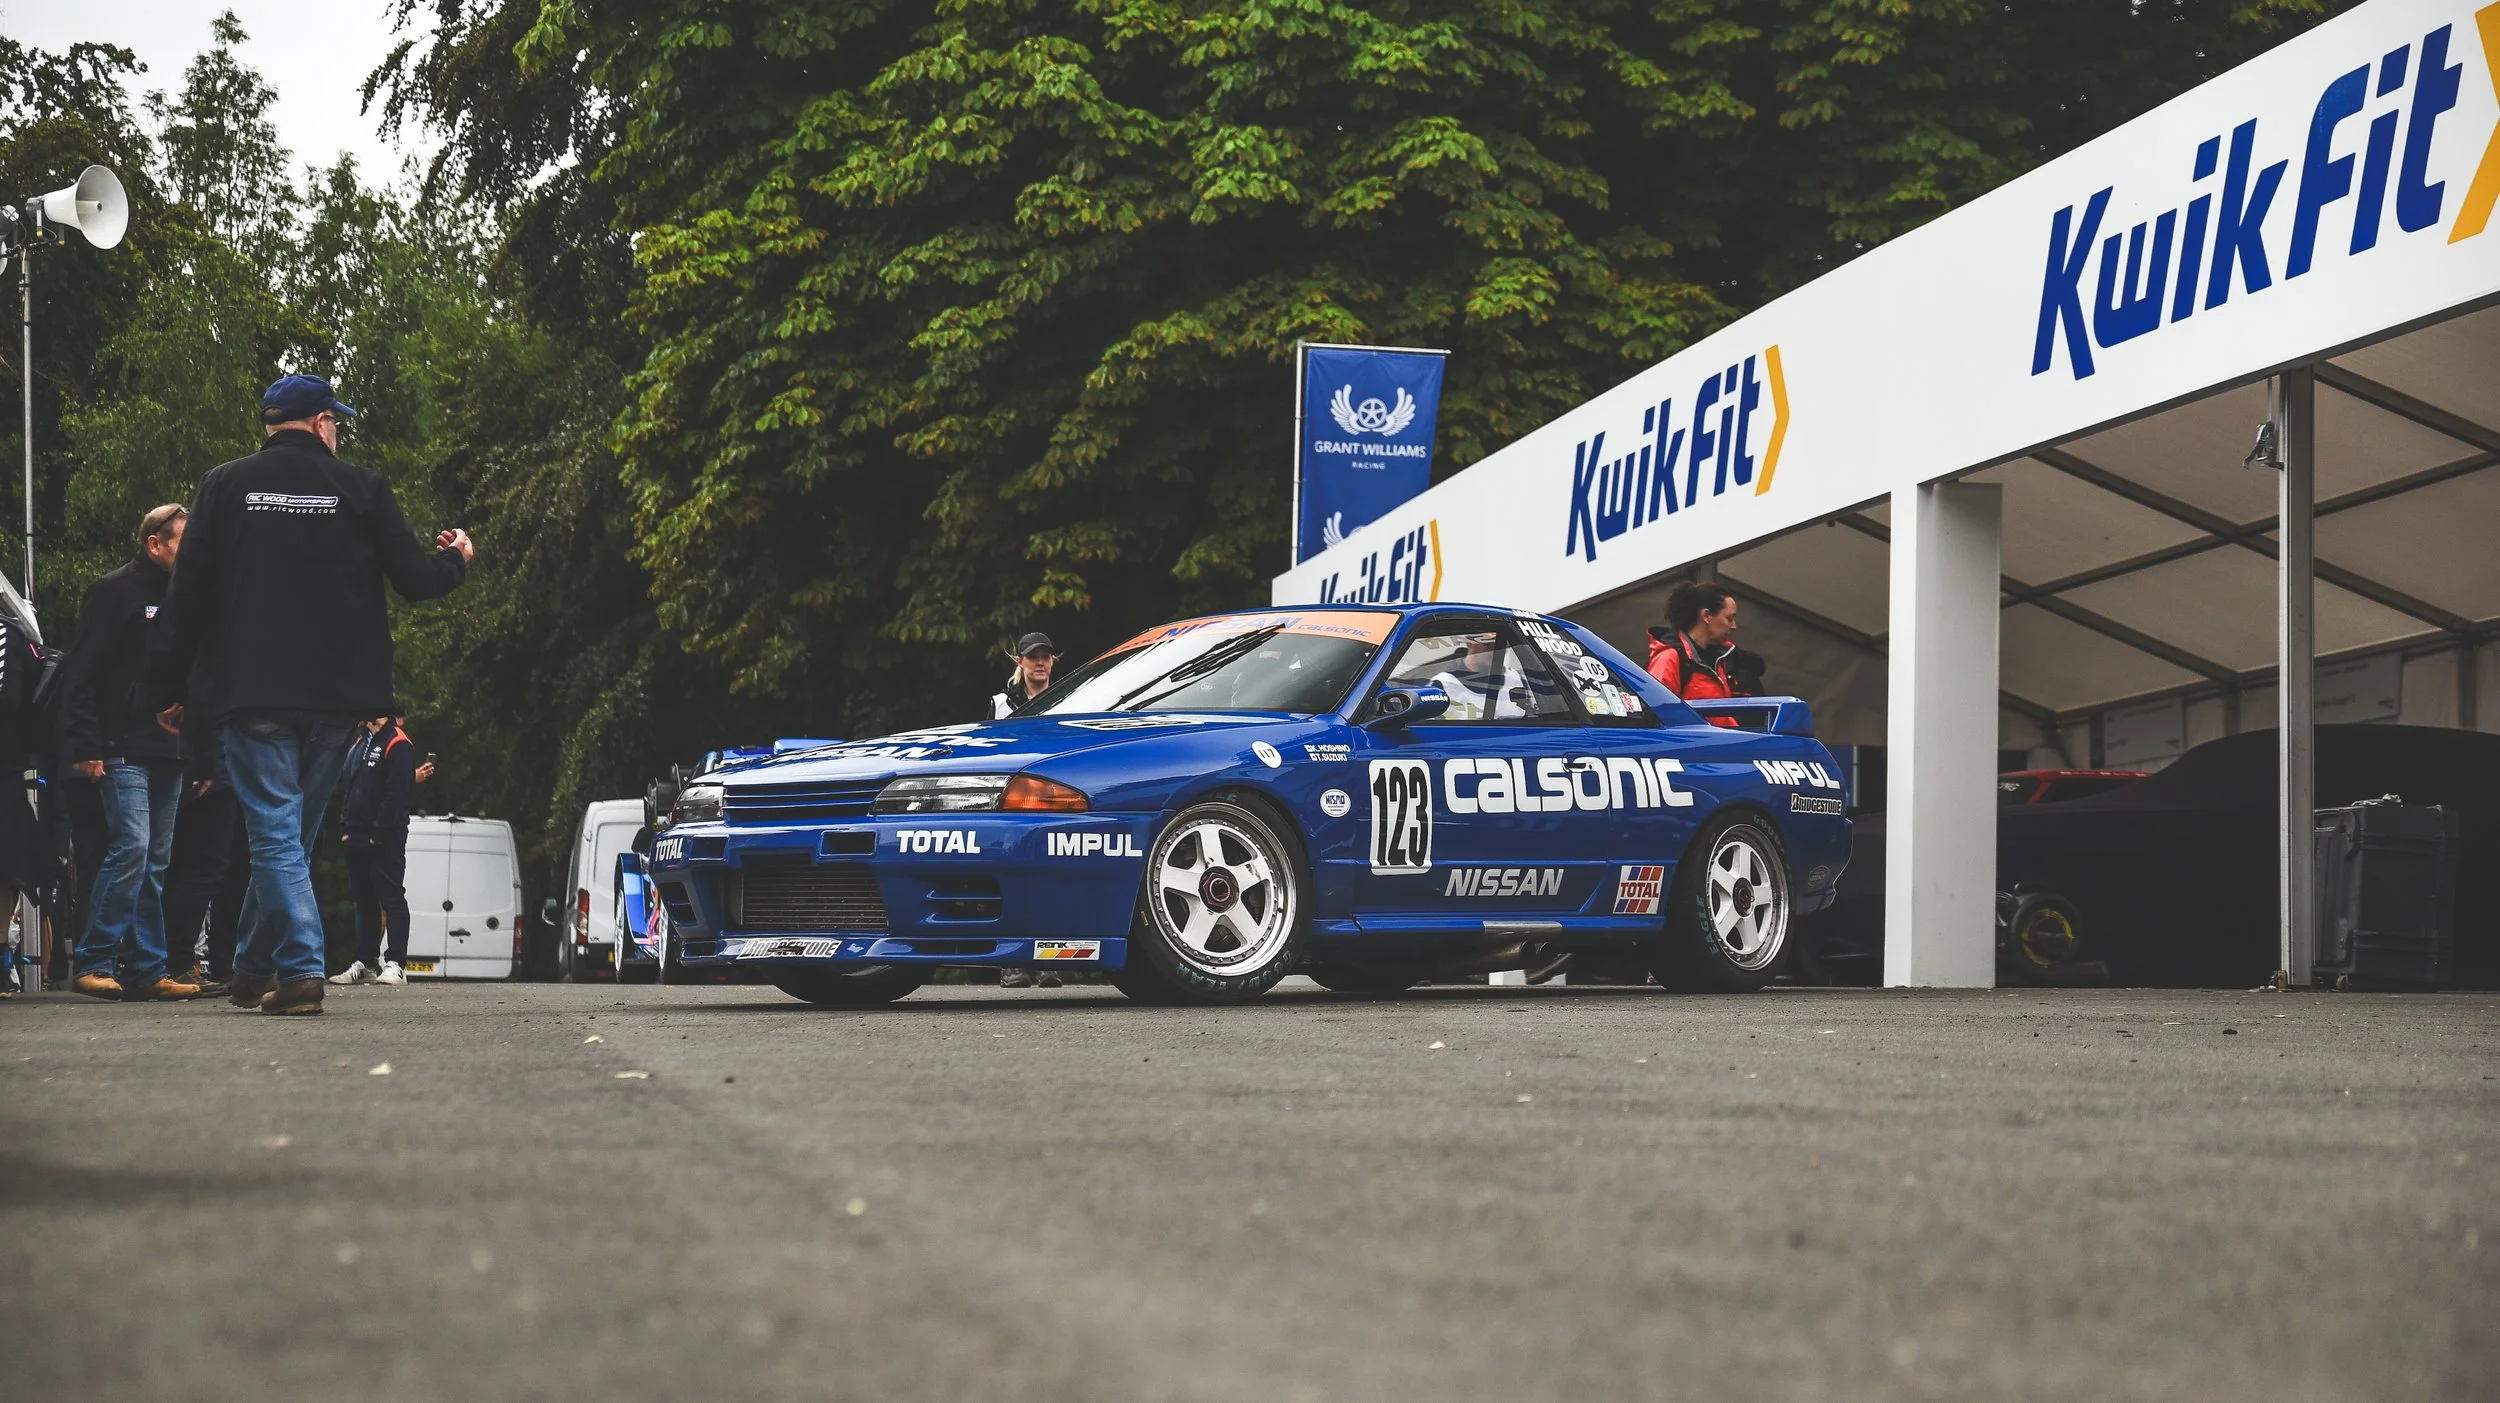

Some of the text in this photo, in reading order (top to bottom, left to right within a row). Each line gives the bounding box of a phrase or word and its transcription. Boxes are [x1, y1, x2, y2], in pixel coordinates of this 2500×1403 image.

[1315, 441, 1427, 458] GRANT WILLIAMS
[1352, 461, 1386, 470] RACING
[263, 495, 287, 503] WOOD
[1516, 620, 1561, 640] HILL
[1534, 637, 1583, 656] WOOD
[1585, 661, 1605, 676] 105
[1420, 693, 1449, 702] NISSAN
[1258, 748, 1276, 759] 117
[1753, 760, 1841, 790] IMPUL
[1325, 794, 1345, 805] NISMO
[1791, 793, 1842, 815] BRIDGESTONE
[1372, 766, 1429, 867] 123
[655, 838, 684, 862] TOTAL
[896, 830, 981, 854] TOTAL
[1047, 832, 1143, 857] IMPUL
[1444, 868, 1564, 897] NISSAN
[1620, 881, 1659, 898] TOTAL
[1696, 895, 1720, 955] EAGLE
